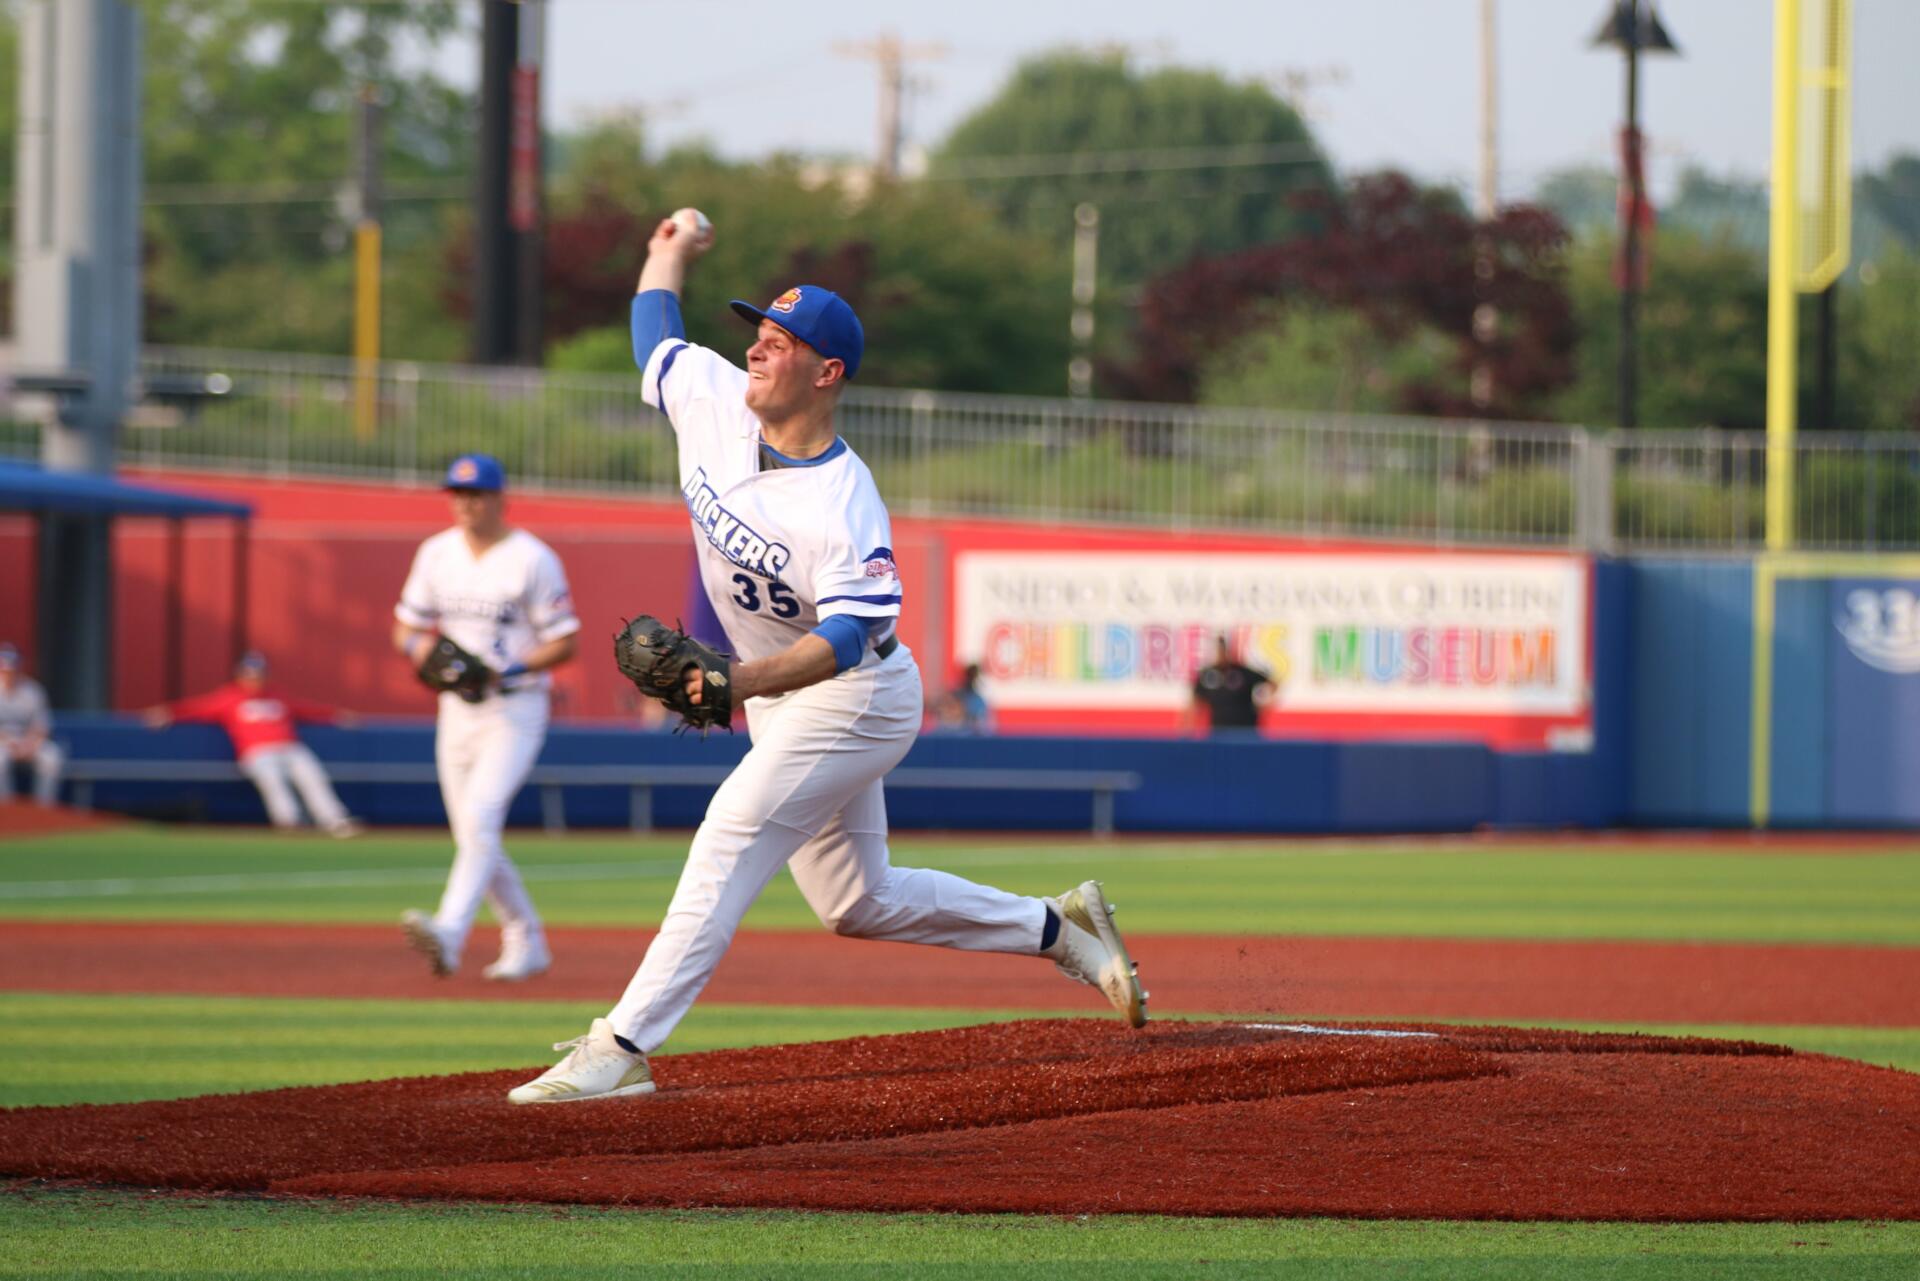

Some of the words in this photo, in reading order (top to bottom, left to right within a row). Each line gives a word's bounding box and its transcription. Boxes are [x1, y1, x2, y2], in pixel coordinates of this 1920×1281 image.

[732, 573, 802, 618] 35
[1845, 587, 1920, 646] 33
[1313, 624, 1558, 687] MUSEUM
